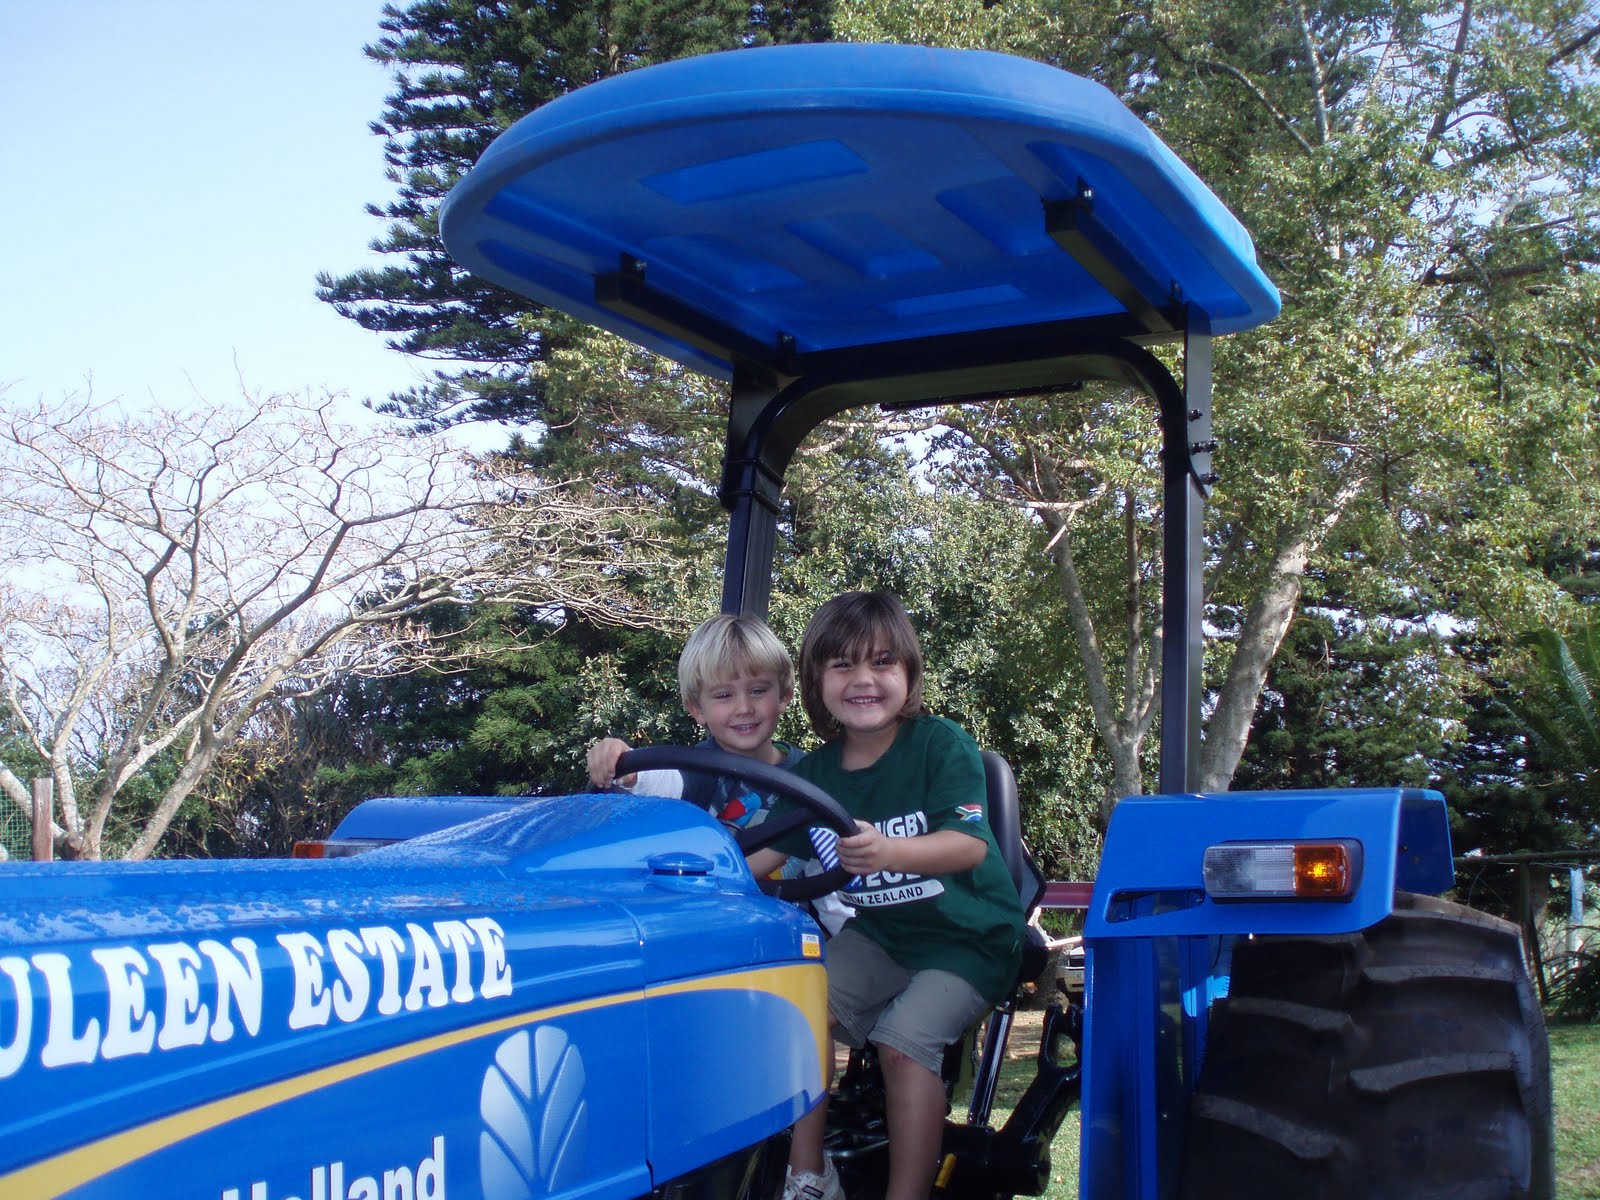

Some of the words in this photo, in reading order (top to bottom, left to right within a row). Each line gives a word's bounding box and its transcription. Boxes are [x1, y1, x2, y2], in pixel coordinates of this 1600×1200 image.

[874, 810, 928, 838] UGBY
[842, 893, 865, 905] NEW
[866, 886, 924, 905] ZEALAND
[276, 917, 513, 1030] ESTATE
[222, 1135, 445, 1200] lland
